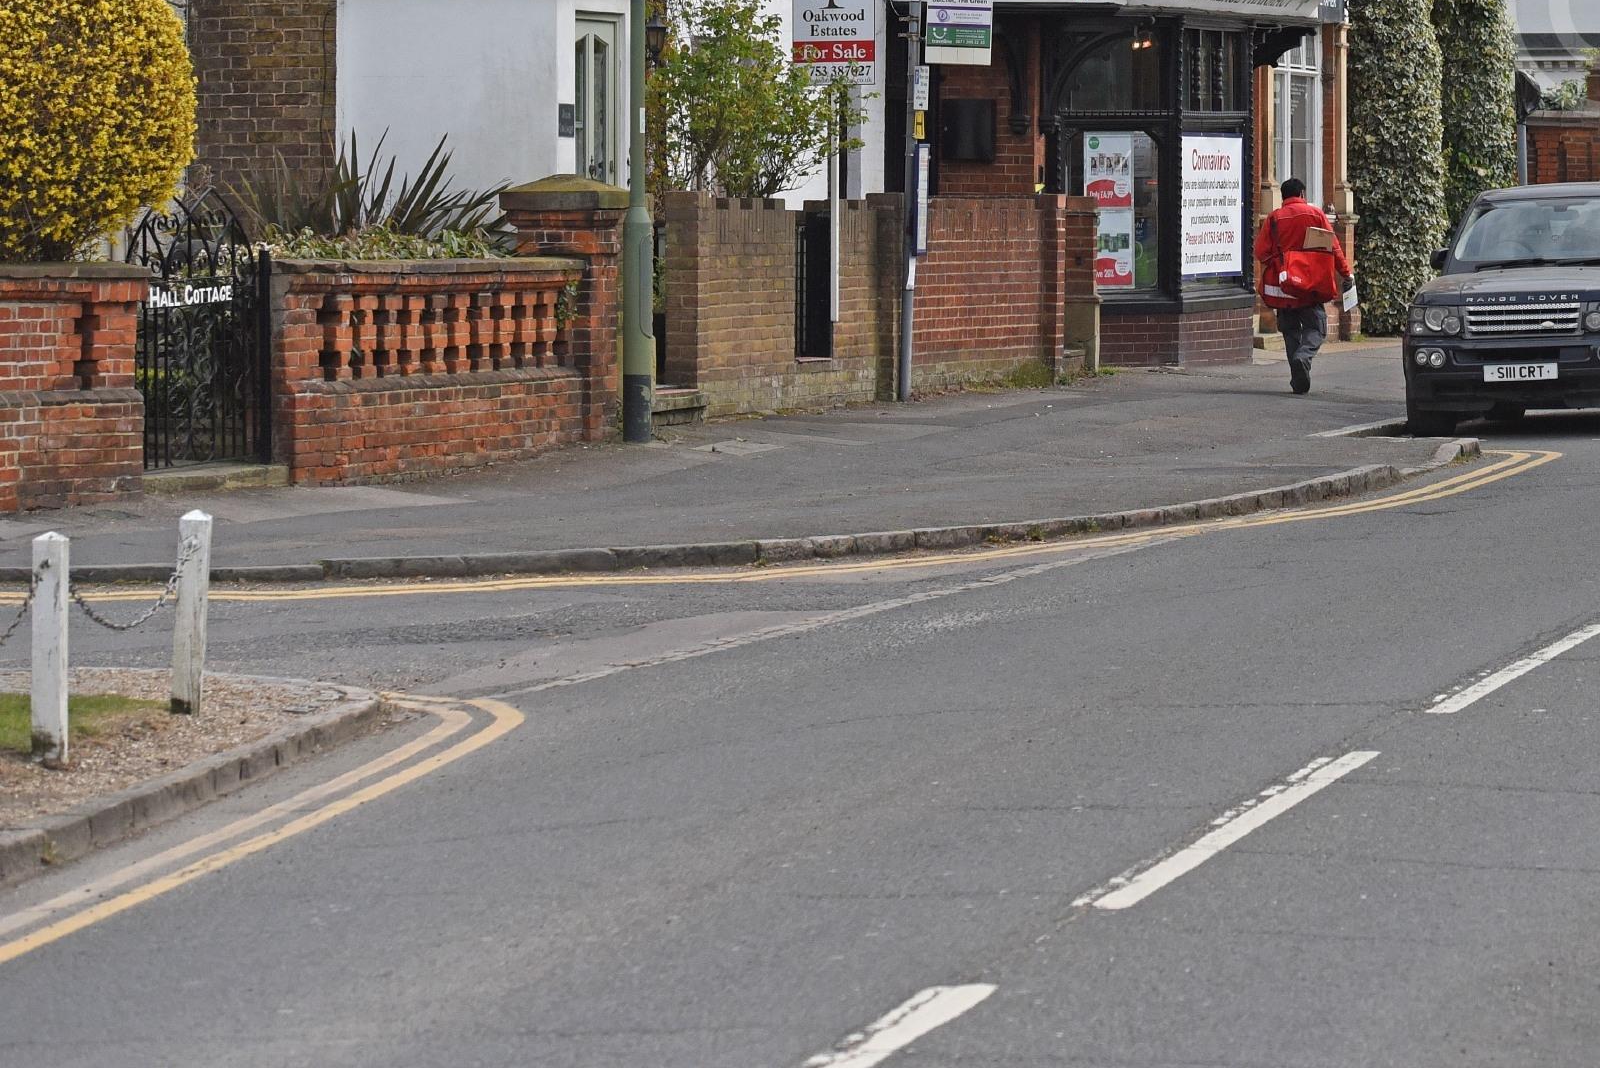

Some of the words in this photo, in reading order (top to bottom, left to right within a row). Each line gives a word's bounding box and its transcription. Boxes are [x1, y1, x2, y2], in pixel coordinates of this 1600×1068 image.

[802, 9, 865, 22] Oakwood
[810, 24, 857, 37] Estates
[802, 44, 829, 60] For
[832, 43, 867, 59] Sale
[1191, 149, 1231, 171] Coronavirus
[149, 286, 181, 308] HALL
[184, 284, 233, 305] COTTAGE
[1465, 295, 1517, 303] RANGE
[1527, 293, 1579, 301] ROVER
[1519, 365, 1545, 378] CRT
